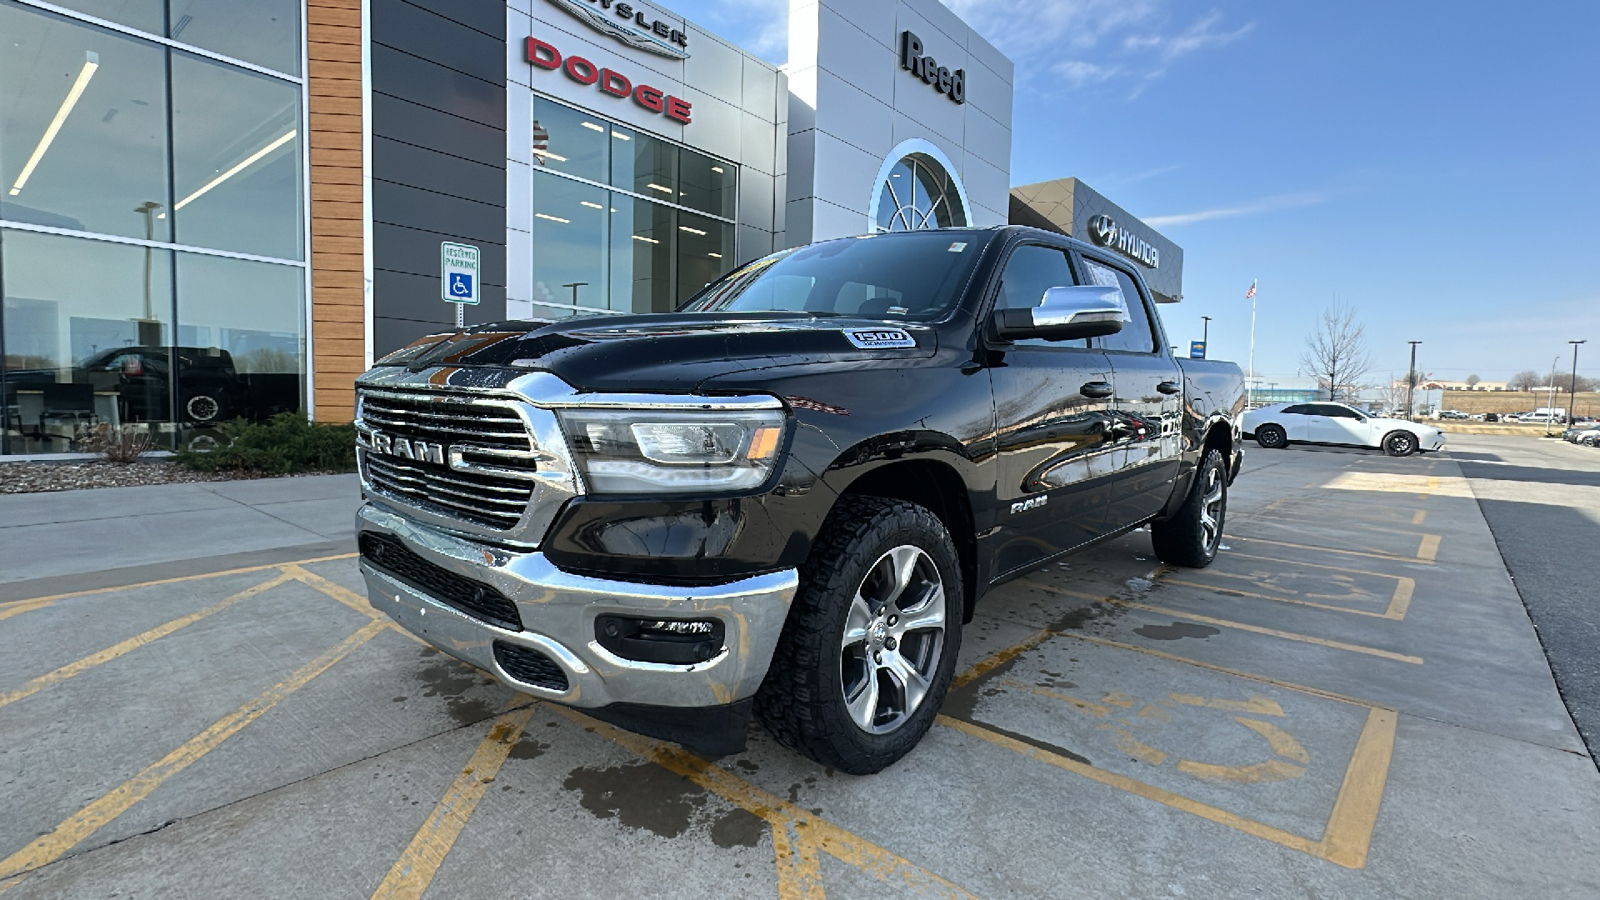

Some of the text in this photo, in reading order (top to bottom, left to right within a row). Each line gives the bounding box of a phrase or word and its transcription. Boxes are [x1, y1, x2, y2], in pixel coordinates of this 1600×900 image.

[524, 35, 692, 125] DODGE
[901, 30, 966, 105] Reed
[446, 248, 475, 260] RESERVED
[1118, 227, 1160, 269] HYUNDAI
[446, 258, 475, 269] PARKING
[854, 332, 903, 341] 1500
[372, 432, 444, 464] RAM
[1010, 495, 1048, 514] RAM
